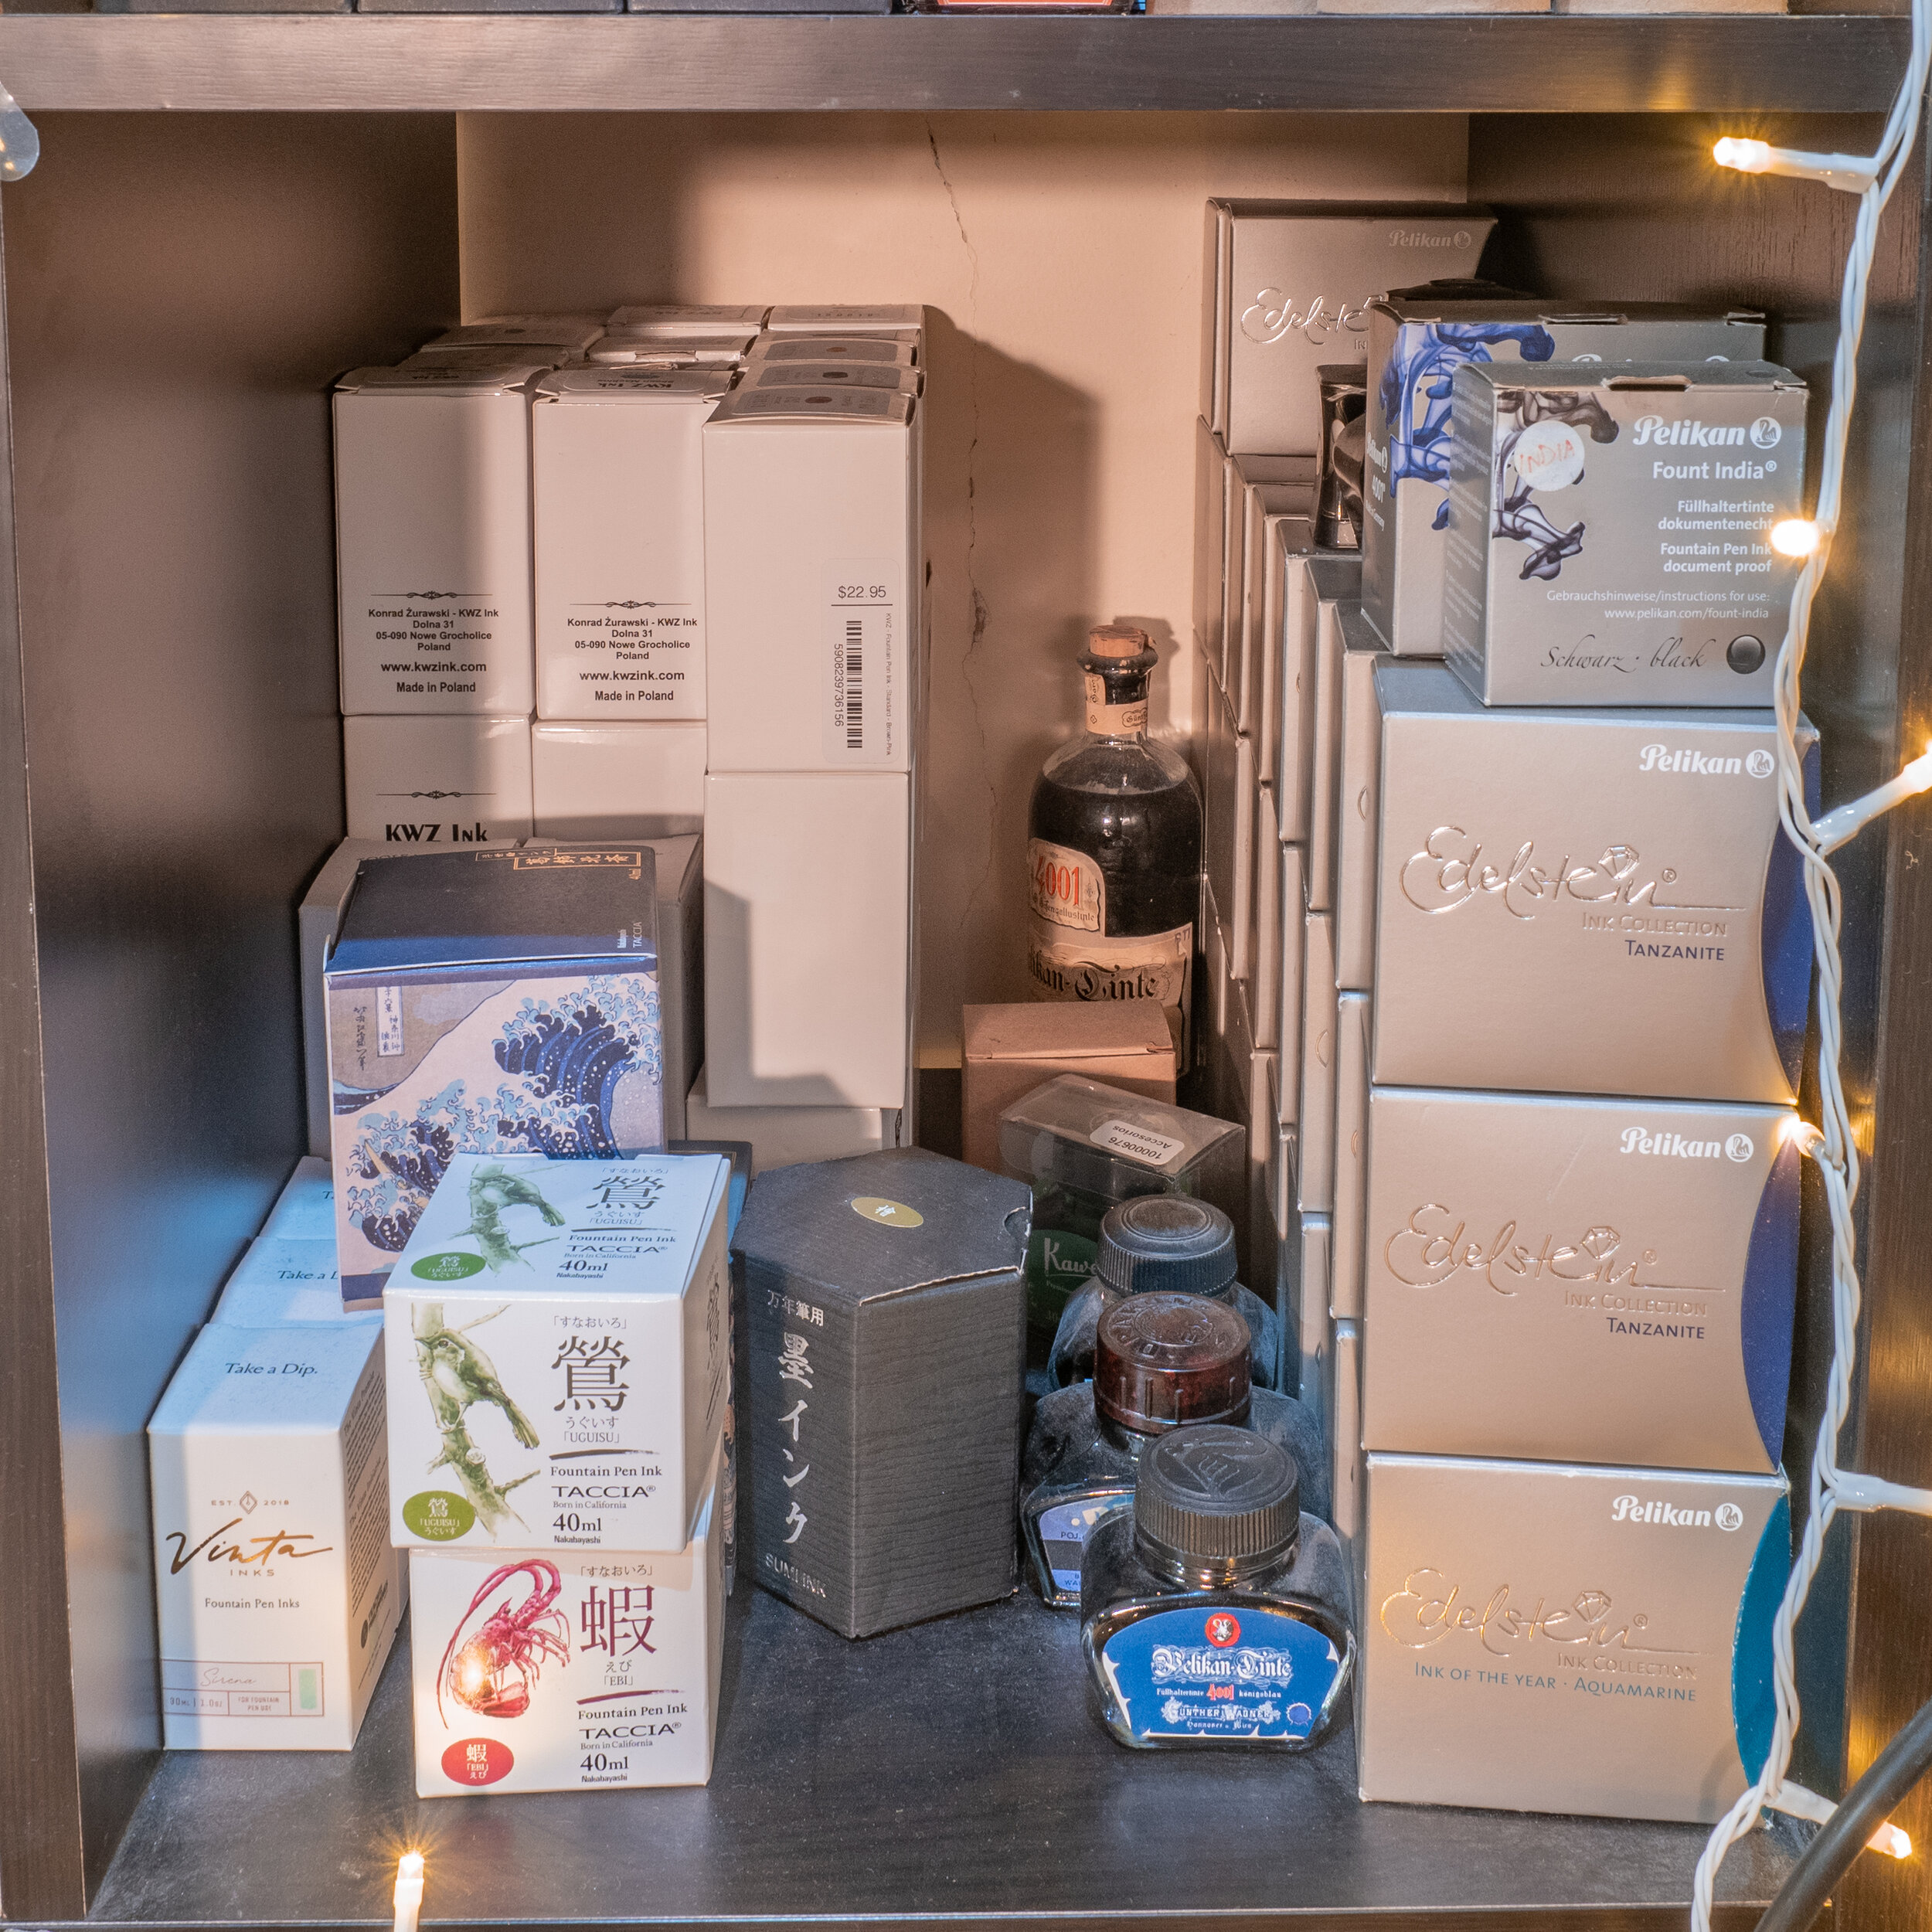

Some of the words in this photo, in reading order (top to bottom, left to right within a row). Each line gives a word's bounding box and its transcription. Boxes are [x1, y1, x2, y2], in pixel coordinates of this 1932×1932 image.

[1389, 231, 1451, 247] Pelikan
[1241, 287, 1370, 345] Edelste
[1633, 415, 1745, 447] Pelikan
[1519, 439, 1575, 474] INDIA
[1653, 462, 1709, 479] Fount
[1678, 500, 1774, 513] Füllhaltertinte
[1658, 517, 1774, 530] dokumentenecht
[1661, 543, 1719, 556] Fountain
[1723, 543, 1748, 556] Pen
[1751, 543, 1772, 556] Ink
[1663, 560, 1731, 573] document
[1735, 560, 1771, 576] proof
[838, 586, 886, 599] $22.95
[1546, 590, 1726, 603] Gebrauchshinweise/instructions
[1729, 590, 1744, 602] for
[1747, 592, 1770, 602] use:
[369, 608, 403, 617] Konrad
[406, 607, 450, 617] Żurawski
[458, 609, 481, 617] KWZ
[485, 608, 499, 617] Ink
[1604, 607, 1769, 621] www.pelikan.com/fount-india
[413, 621, 440, 629] Dolna
[443, 621, 454, 629] 31
[567, 618, 601, 627] Konrad
[605, 617, 648, 627] Żurawski
[657, 618, 679, 627] KWZ
[683, 617, 698, 626] Ink
[376, 631, 406, 640] 05-090
[410, 631, 437, 640] Nowe
[440, 631, 492, 640] Grocholice
[417, 643, 451, 651] Poland
[575, 641, 605, 649] 05-090
[609, 641, 635, 649] Nowe
[638, 641, 690, 649] Grocholice
[616, 651, 649, 660] Poland
[1541, 634, 1637, 673] Schwarz
[1650, 637, 1716, 668] black
[381, 662, 487, 672] www.kwzink.com
[580, 671, 685, 681] www.kwzink.com
[396, 682, 424, 692] Made
[427, 682, 437, 692] in
[440, 682, 476, 692] Poland
[834, 643, 844, 727] 5908239736156
[595, 691, 623, 701] Made
[626, 691, 634, 701] in
[638, 691, 674, 701] Poland
[1639, 744, 1741, 774] Pelikan
[386, 824, 441, 842] KWZ
[452, 822, 488, 842] Ink
[633, 921, 642, 948] TACCIA
[1624, 940, 1725, 961] TANZANITE
[1112, 1125, 1172, 1148] Accesorios
[1621, 1127, 1721, 1158] Pelikan
[1108, 1137, 1162, 1159] 10000676
[586, 1175, 666, 1210] 鶯
[558, 1260, 608, 1272] 40ml
[277, 1270, 313, 1280] Take
[1607, 1317, 1705, 1339] TANZANITE
[225, 1362, 264, 1375] Take
[281, 1362, 318, 1378] Dip.
[551, 1335, 631, 1412] 鶯
[565, 1417, 619, 1429] うぐいす
[779, 1332, 815, 1544] 墨インク
[550, 1466, 611, 1477] Fountain
[614, 1467, 638, 1477] Pen
[641, 1465, 662, 1476] Ink
[1612, 1495, 1711, 1527] Pelikan
[553, 1512, 602, 1532] 40ml
[166, 1518, 333, 1575] Vinta
[554, 1536, 601, 1544] Nakabayashi
[205, 1597, 251, 1609] Fountain
[255, 1598, 275, 1609] Pen
[279, 1598, 300, 1608] Inks
[580, 1585, 657, 1657] 蝦
[605, 1660, 632, 1673] えび
[200, 1667, 256, 1687] Sirena
[1415, 1662, 1444, 1679] INK
[1450, 1667, 1472, 1681] OF
[1476, 1670, 1509, 1685] THE
[1515, 1674, 1556, 1689] YEAR
[1574, 1676, 1696, 1702] AQUAMARINE
[1206, 1683, 1235, 1701] 4001
[578, 1708, 637, 1720] Fountain
[641, 1706, 664, 1716] Pen
[667, 1703, 688, 1714] Ink
[611, 1740, 654, 1749] California
[467, 1743, 488, 1763] 蝦
[580, 1752, 629, 1771] 40ml
[581, 1774, 628, 1783] Nakabayashi
